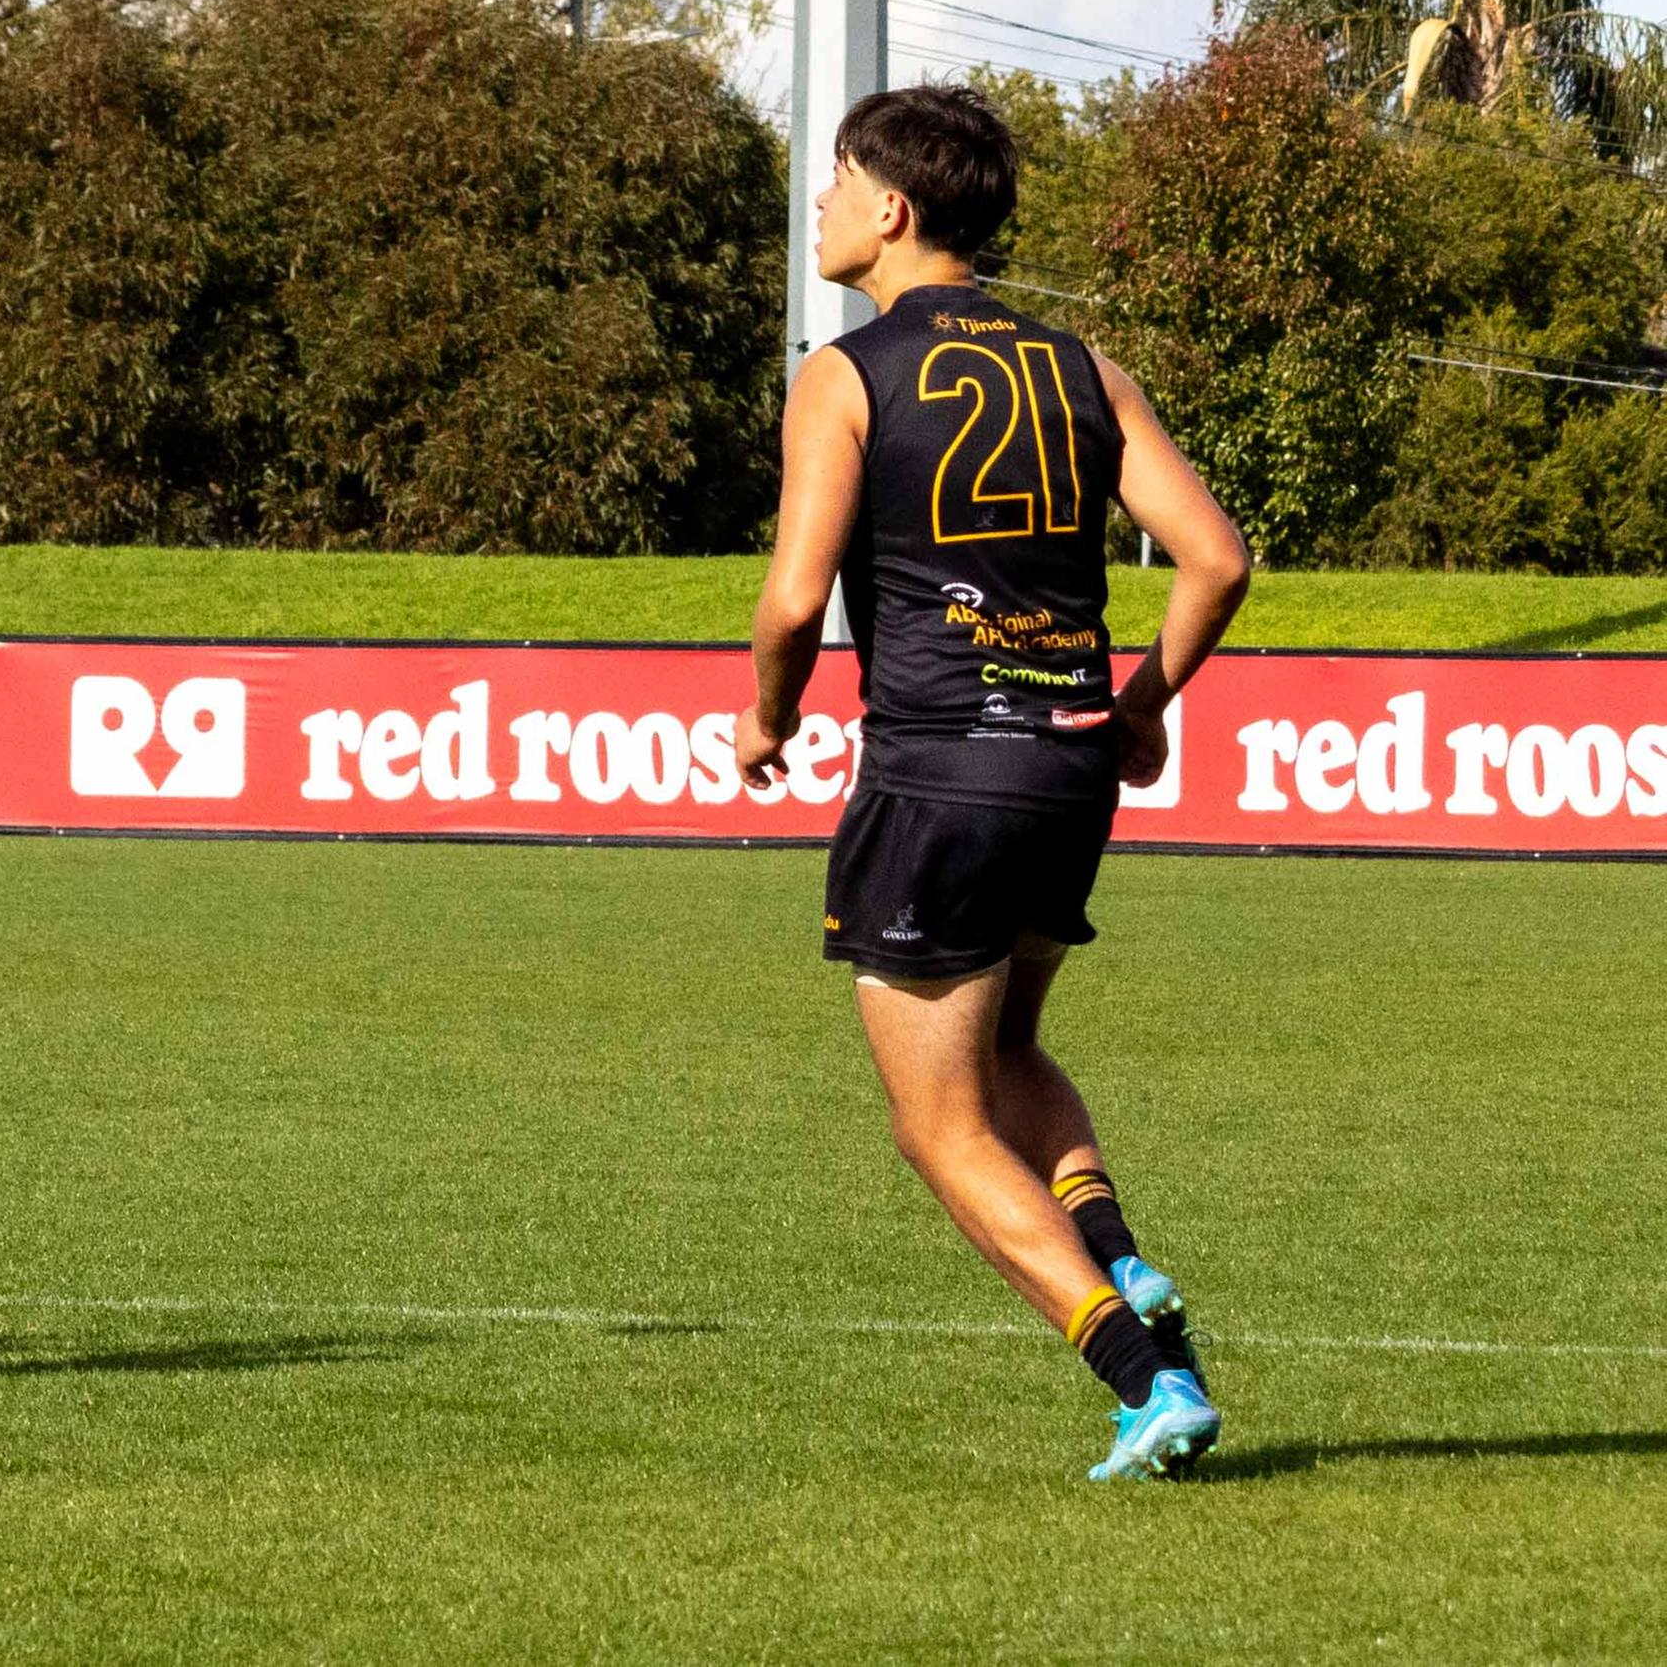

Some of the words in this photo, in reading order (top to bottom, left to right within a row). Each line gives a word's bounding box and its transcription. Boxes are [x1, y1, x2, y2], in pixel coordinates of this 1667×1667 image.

[956, 317, 1017, 335] Tjindu
[919, 341, 1080, 543] 21
[945, 603, 1053, 634] Abiginal
[300, 679, 496, 801] red
[509, 710, 864, 805] roose
[1237, 690, 1432, 814] red
